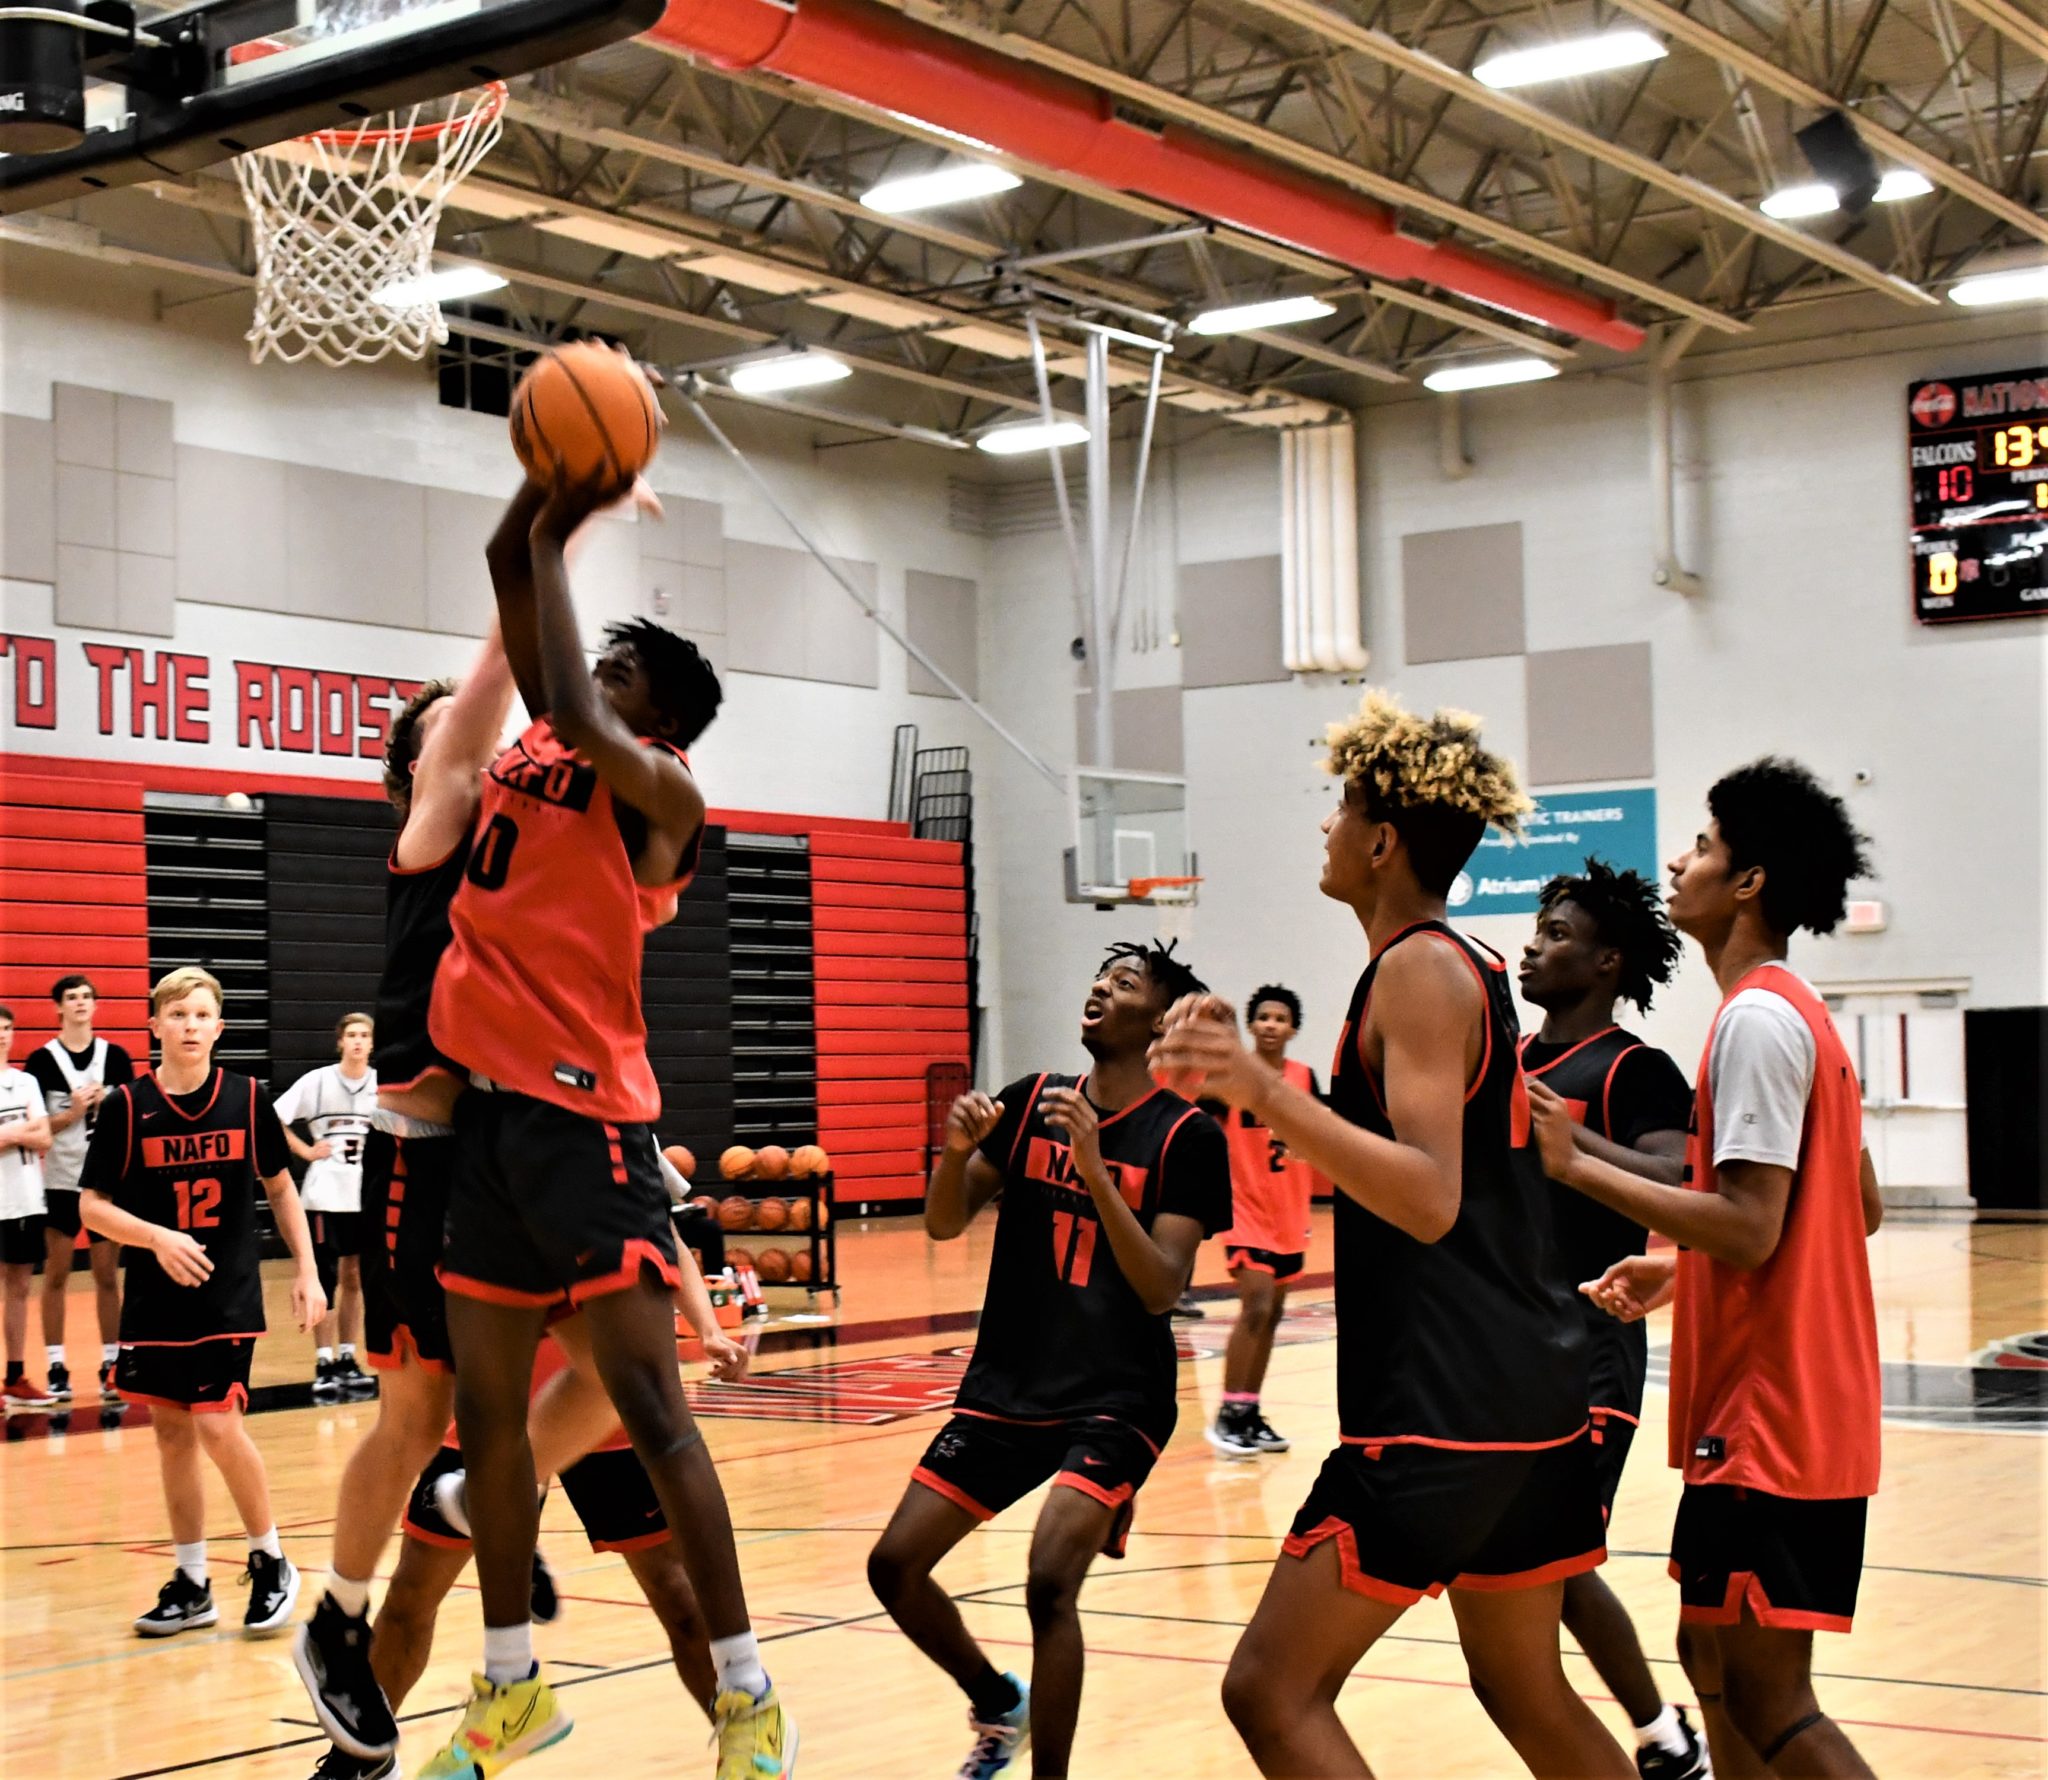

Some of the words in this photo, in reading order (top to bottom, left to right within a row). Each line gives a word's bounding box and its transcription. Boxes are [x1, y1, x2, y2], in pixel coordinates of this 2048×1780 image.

[1911, 440, 1976, 468] FALCONS
[1938, 465, 1973, 502] 10
[82, 642, 209, 744] THE
[1554, 807, 1624, 824] TRAINERS
[467, 813, 519, 892] 0
[1477, 876, 1540, 895] Atrium
[161, 1133, 230, 1163] NAFO
[1268, 1139, 1287, 1173] 2
[173, 1178, 222, 1230] 12
[1053, 1210, 1097, 1288] 11
